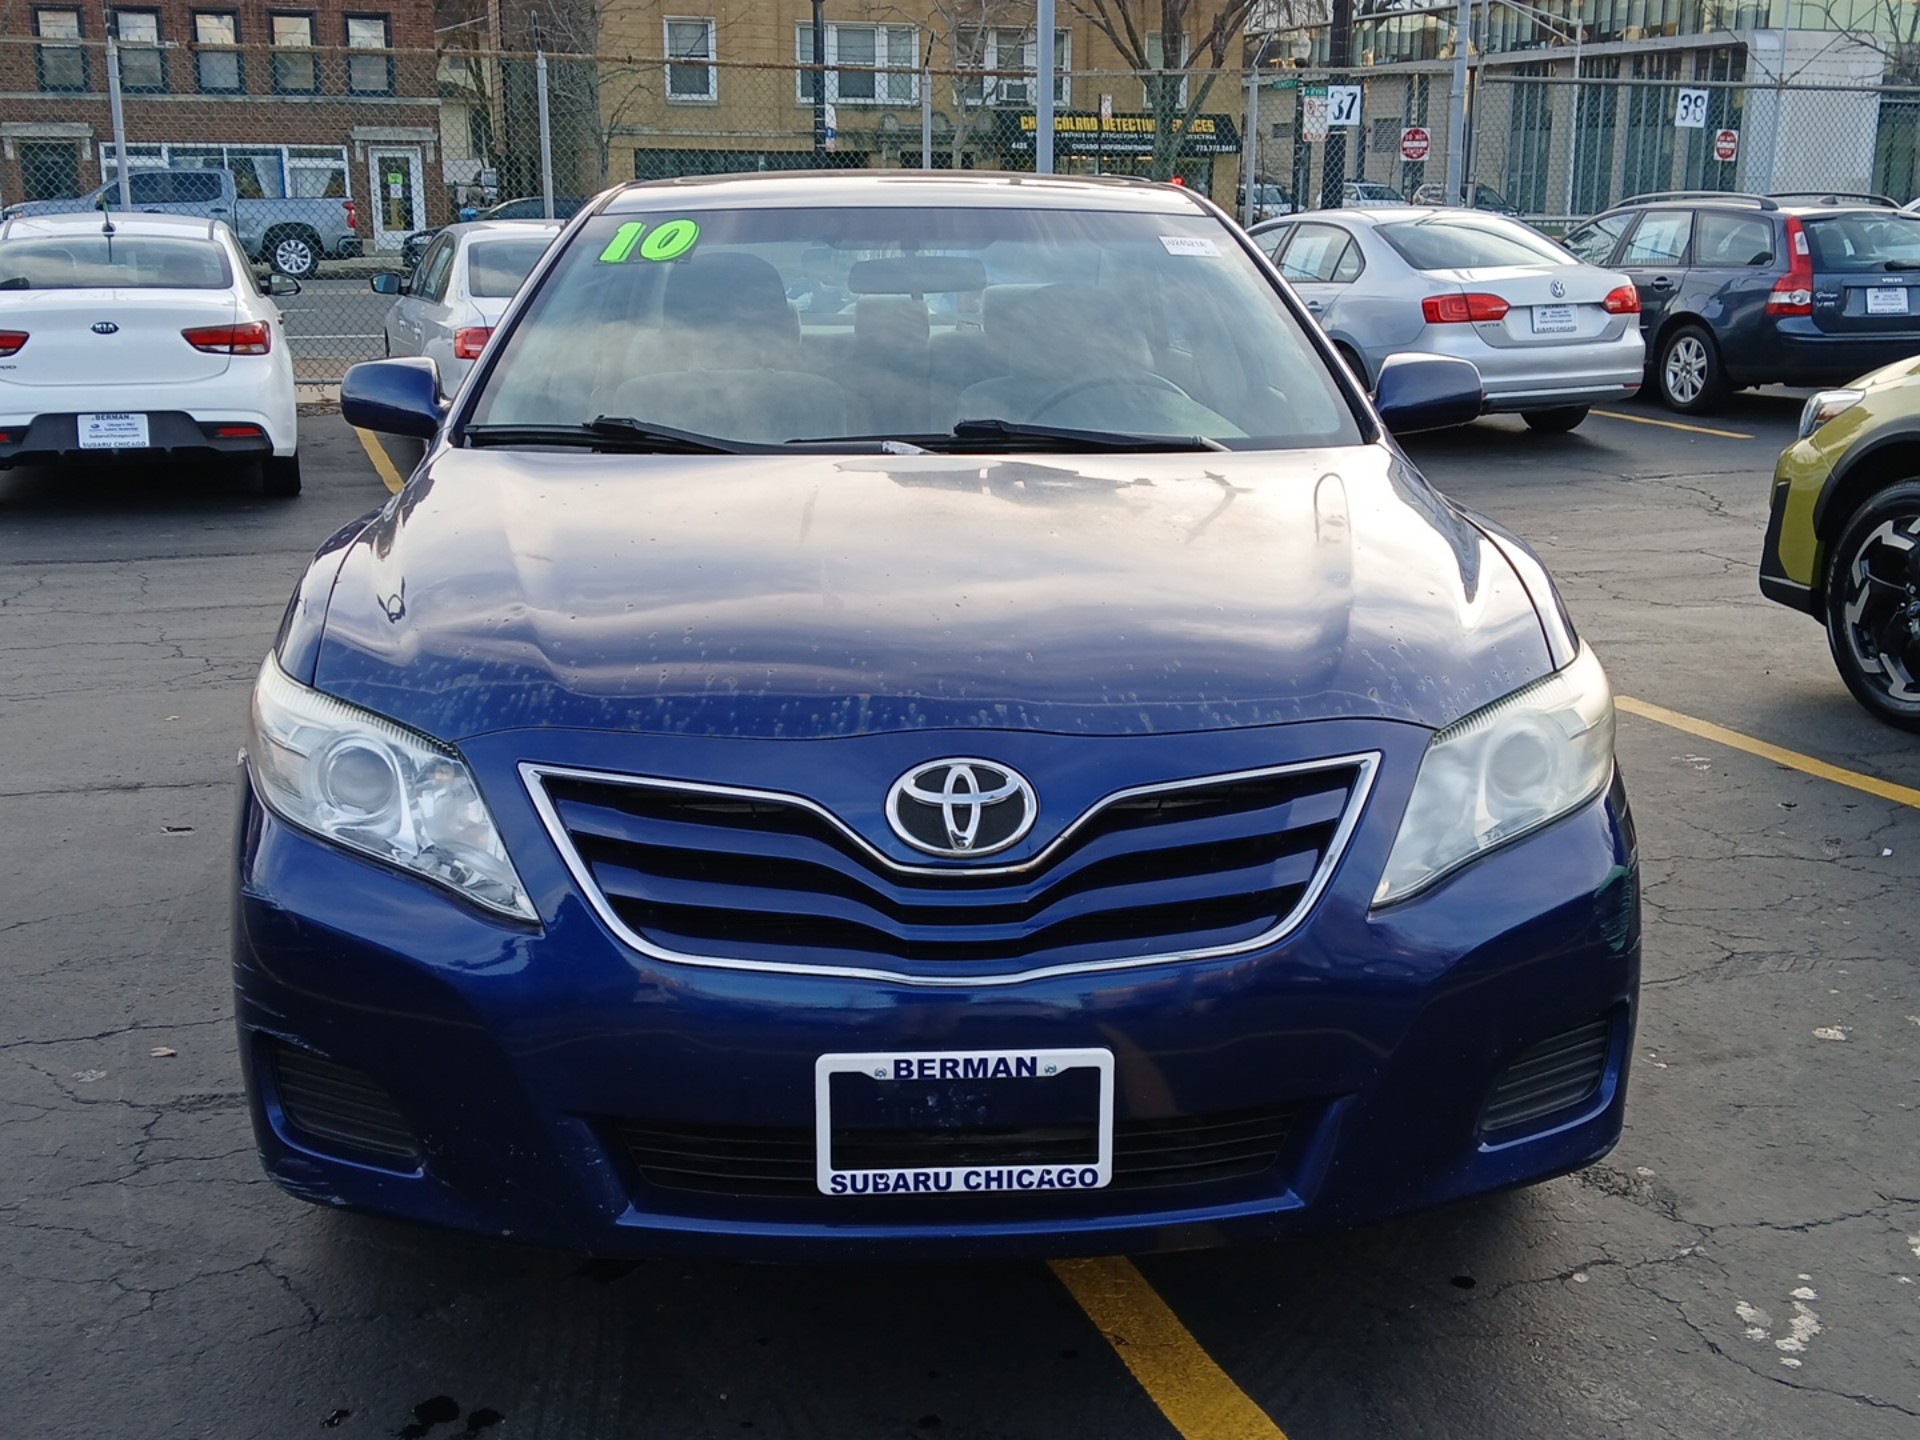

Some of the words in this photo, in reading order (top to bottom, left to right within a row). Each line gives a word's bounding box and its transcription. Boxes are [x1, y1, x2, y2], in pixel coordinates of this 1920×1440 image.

[1330, 90, 1358, 121] 37
[1680, 93, 1706, 123] 38
[1021, 115, 1098, 131] CHGOLAND
[1102, 118, 1156, 132] DETECTIV
[599, 218, 700, 264] 10
[892, 1056, 1038, 1079] BERMAN
[830, 1170, 953, 1194] SUBARU
[963, 1168, 1099, 1189] CHICAGO
